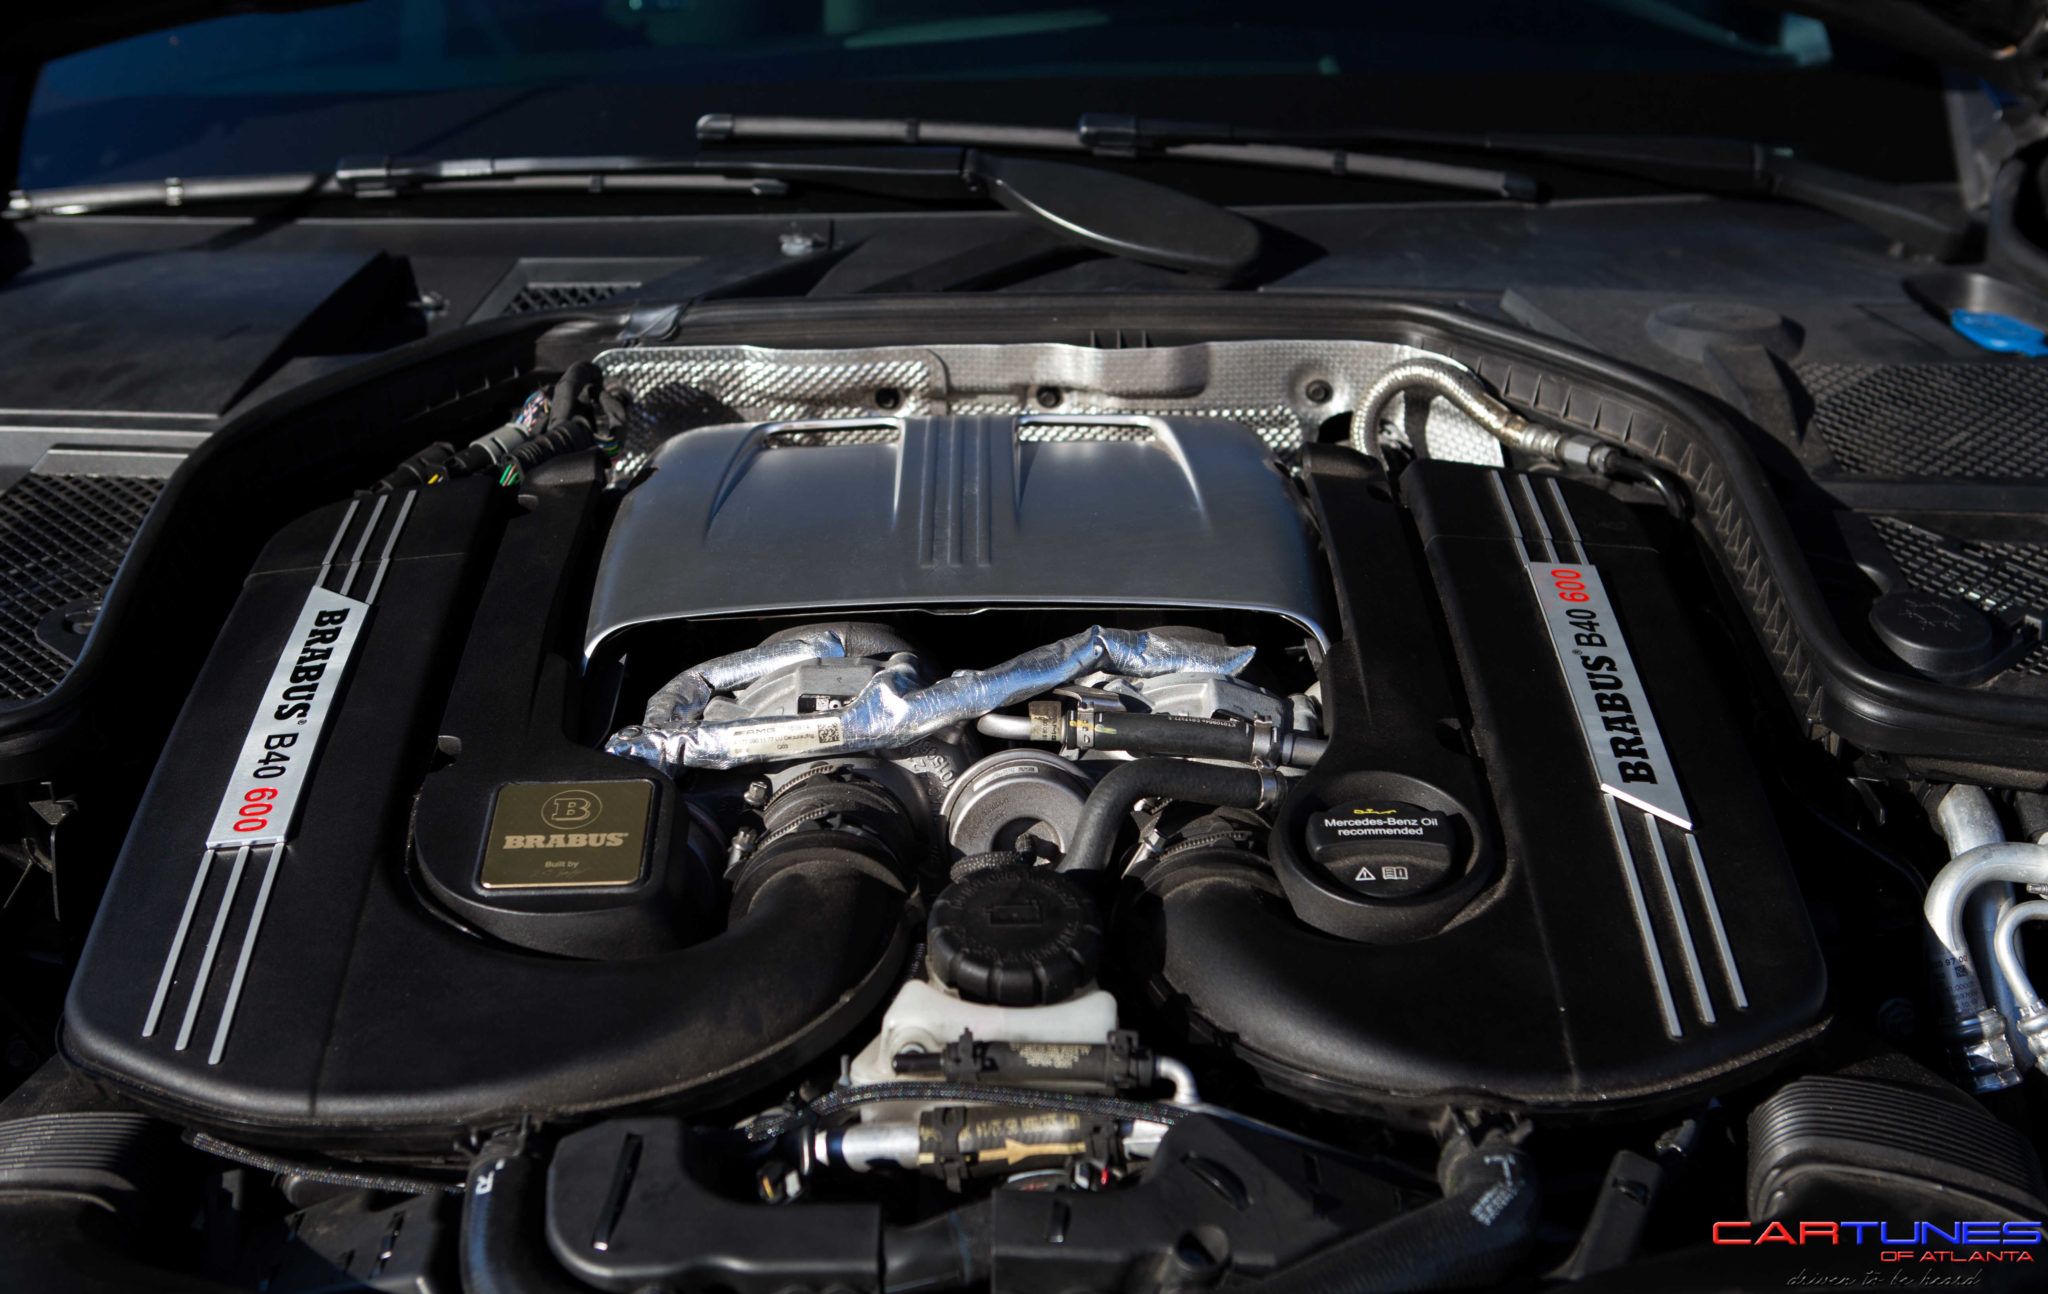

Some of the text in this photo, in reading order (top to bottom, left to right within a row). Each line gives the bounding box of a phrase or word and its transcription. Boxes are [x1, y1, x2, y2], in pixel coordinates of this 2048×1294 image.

[1550, 568, 1590, 603] 600
[1565, 608, 1607, 648] B40
[252, 732, 299, 779] B40
[232, 786, 279, 833] 600
[1323, 817, 1439, 828] Mercedes-Benz Oil
[502, 832, 629, 850] BRABUS
[1337, 826, 1424, 837] recommended
[544, 860, 580, 869] Built by
